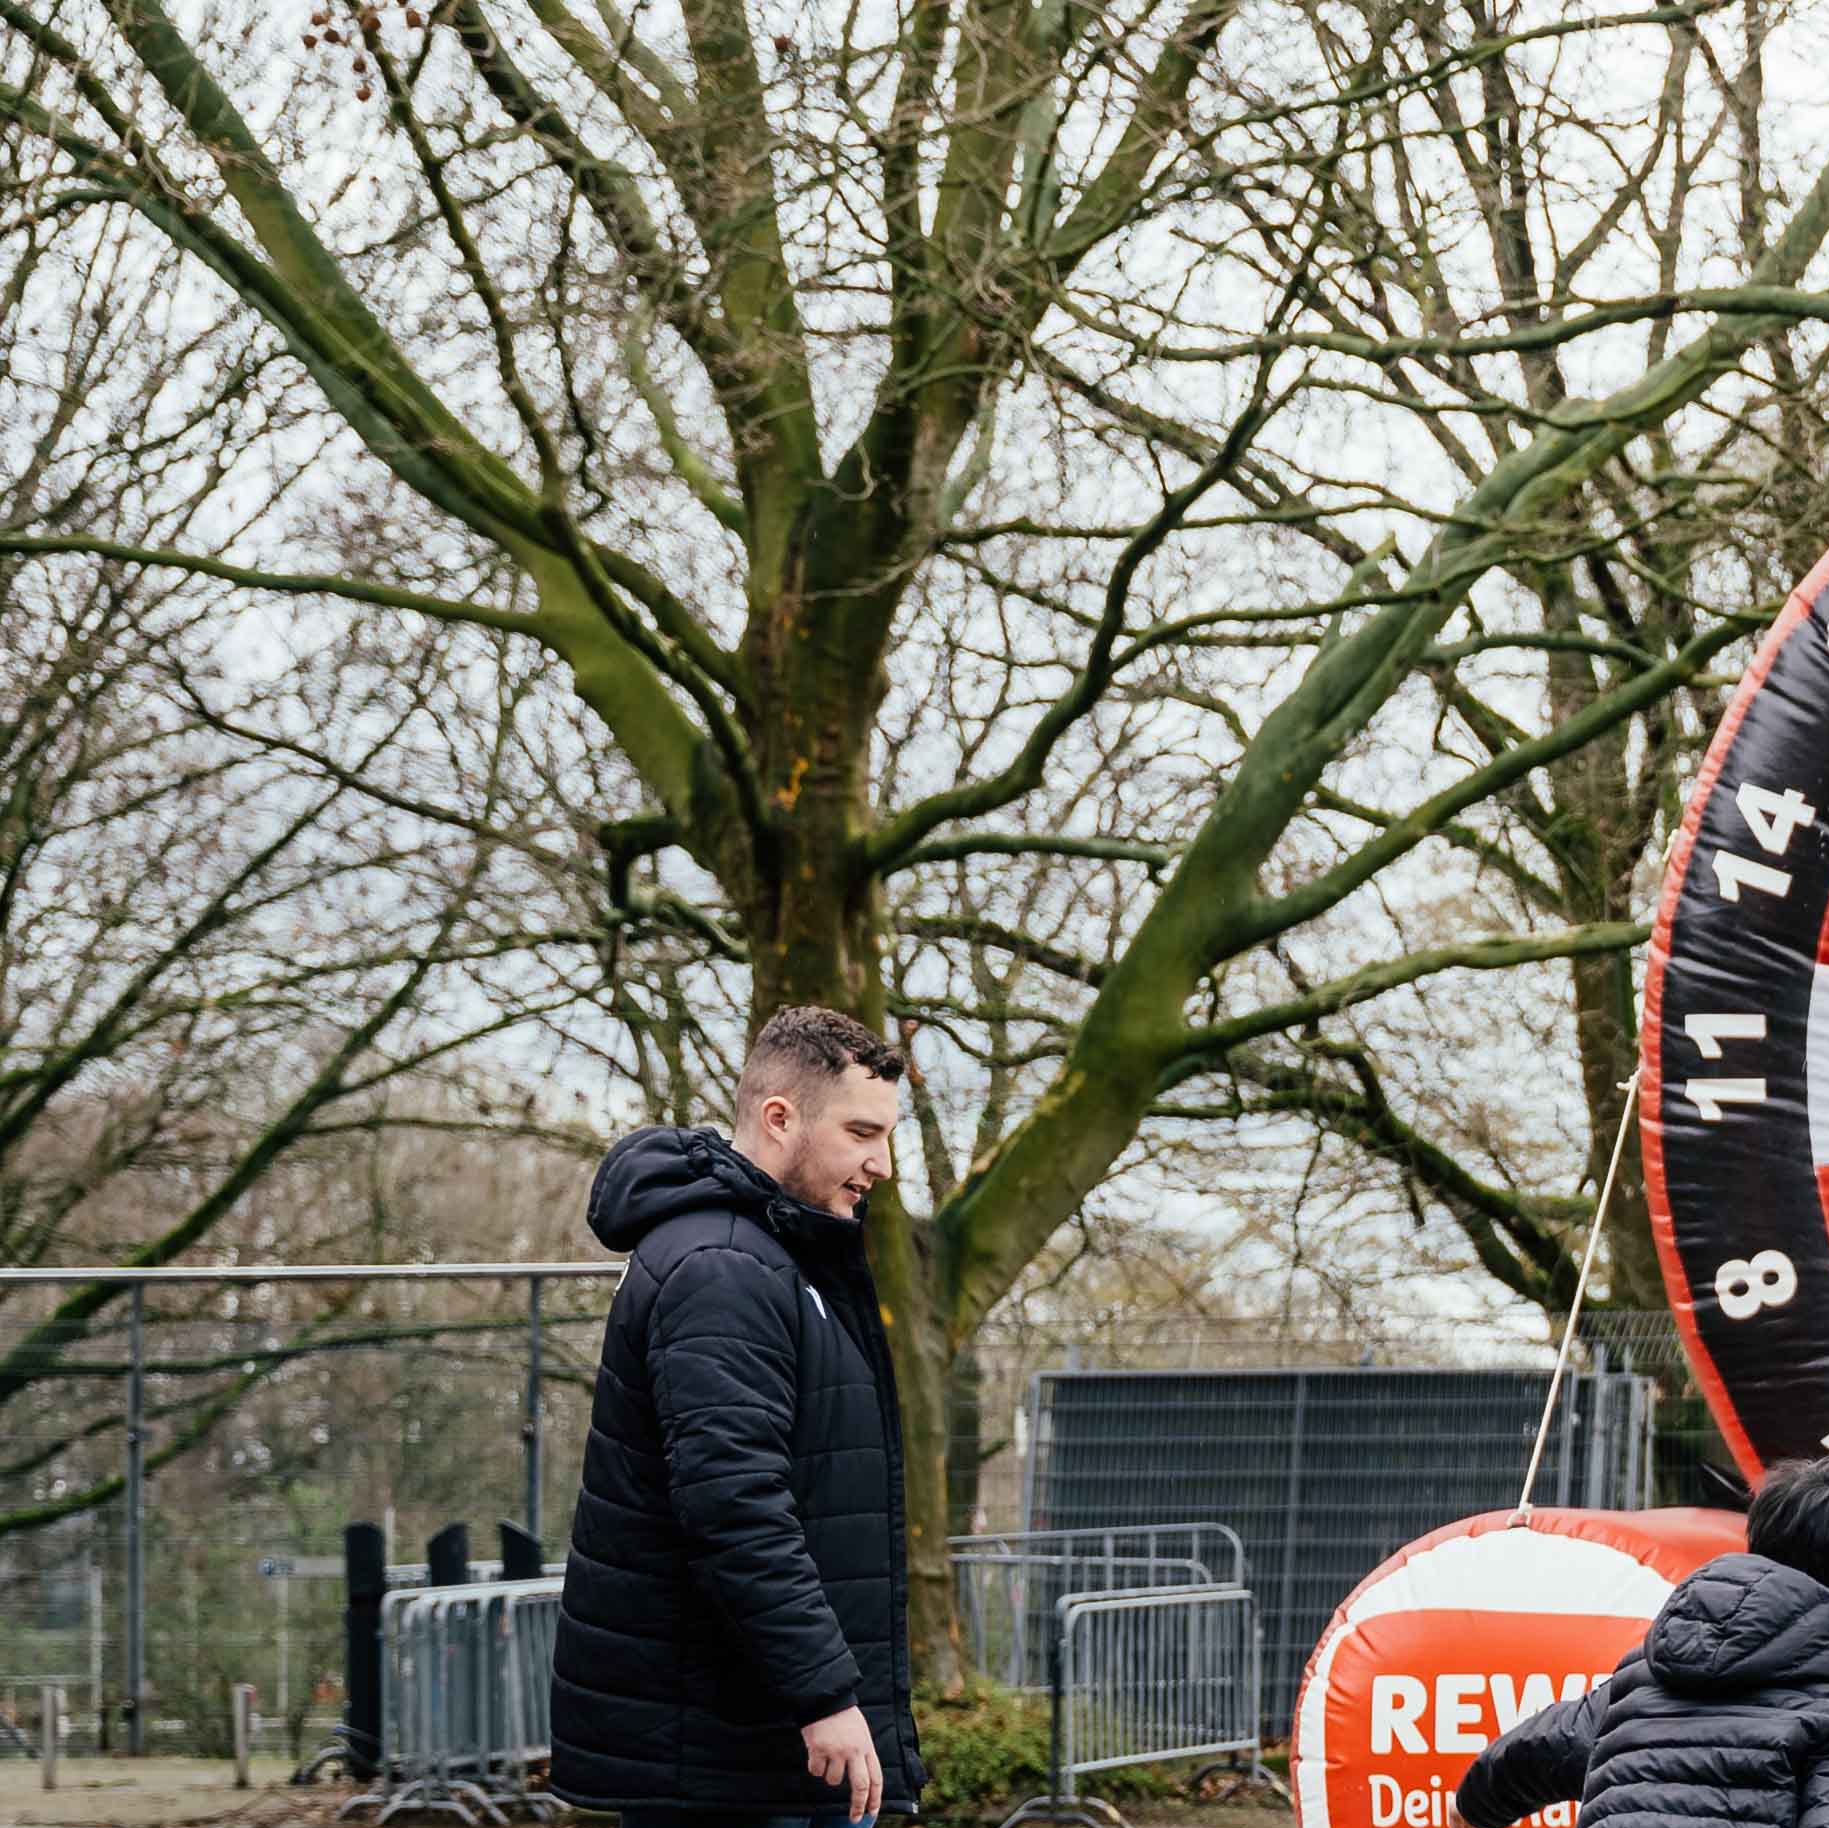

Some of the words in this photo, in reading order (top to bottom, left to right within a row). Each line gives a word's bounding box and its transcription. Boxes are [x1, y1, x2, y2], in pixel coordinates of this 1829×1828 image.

[1711, 782, 1816, 902] 14
[1684, 1013, 1767, 1121] 11
[1714, 1249, 1798, 1320] 8
[1371, 1673, 1612, 1755] REW
[1368, 1773, 1457, 1828] Dei
